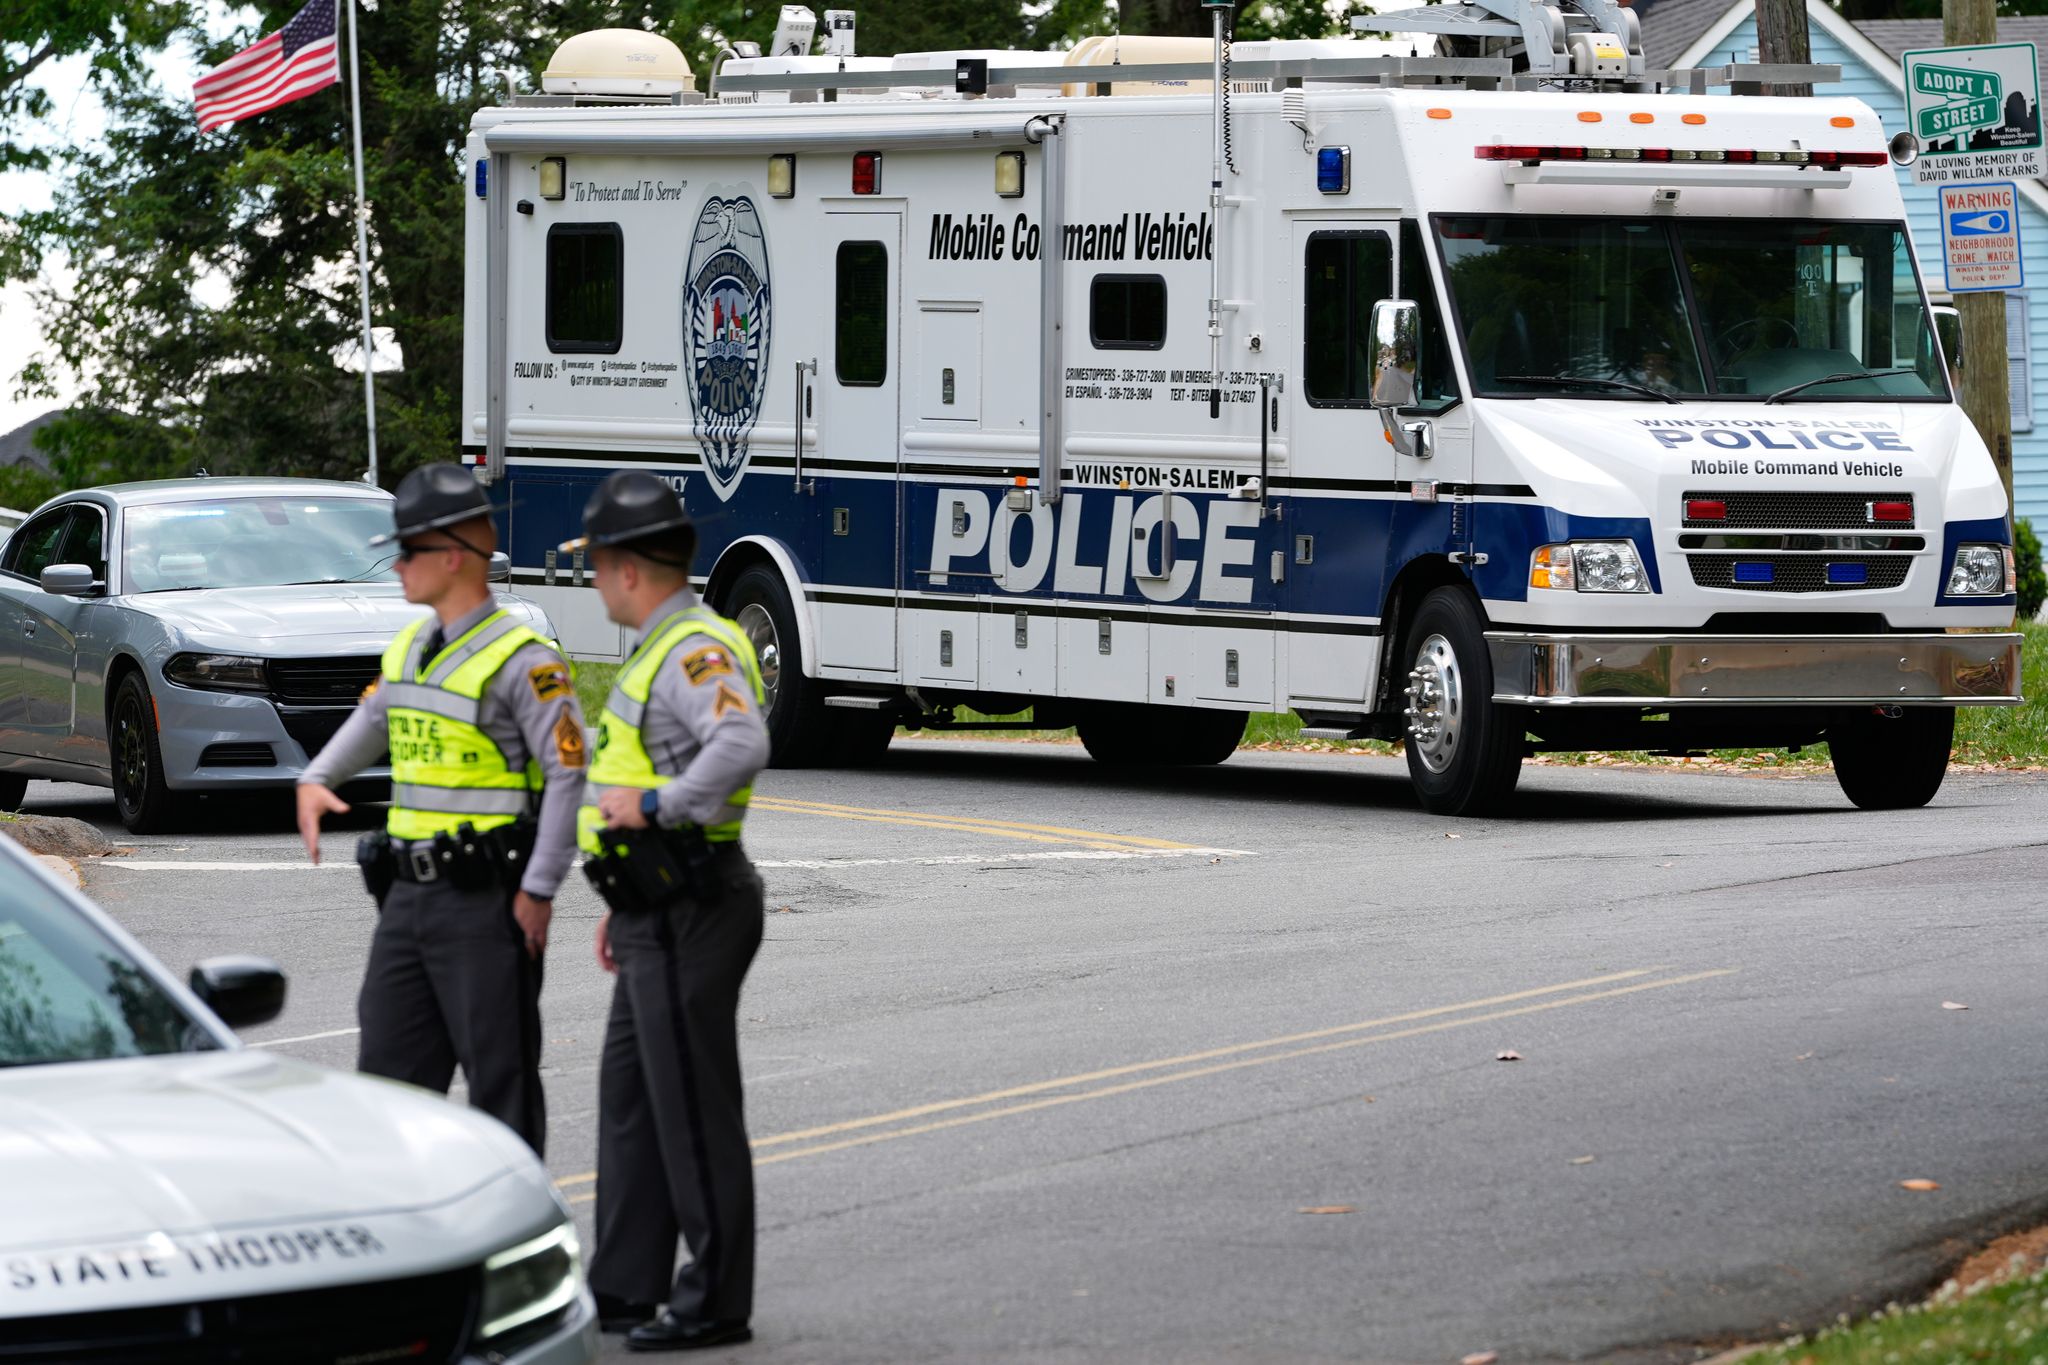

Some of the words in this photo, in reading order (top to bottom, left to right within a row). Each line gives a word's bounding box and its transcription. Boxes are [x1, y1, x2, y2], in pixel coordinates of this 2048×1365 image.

[1923, 72, 1974, 93] ADOPT
[1982, 79, 1993, 95] A
[1932, 104, 1986, 129] STREET
[1990, 131, 2037, 141] Winston-Salem
[2000, 138, 2028, 146] Beautiful
[1921, 159, 1931, 170] IN
[1936, 156, 1971, 169] LOVING
[1975, 153, 2018, 168] MEMORY
[2023, 152, 2036, 163] OF
[1920, 170, 1948, 181] DAVID
[1952, 167, 1993, 180] WILLIAM
[1999, 164, 2039, 177] KEARNS
[587, 181, 620, 202] Protect
[621, 180, 641, 201] and
[643, 181, 654, 201] To
[1946, 191, 2011, 209] WARNING
[928, 212, 1006, 261] Mobile
[1011, 211, 1129, 262] Comand
[1949, 237, 2014, 250] NEIGHBORHOOD
[1951, 252, 1977, 264] CRIME
[1987, 251, 2014, 262] WATCH
[513, 362, 542, 378] FOLLOW
[543, 363, 554, 378] US
[1065, 367, 1116, 381] CRIMESTOPPERS
[1121, 369, 1167, 383] 336-727-2800
[1170, 370, 1185, 383] NON
[1185, 370, 1224, 384] EMERGEY
[700, 362, 754, 414] POLICE
[1065, 385, 1075, 399] EN
[1075, 383, 1102, 399] ESPAÑOL
[1170, 388, 1186, 401] TEXT
[1191, 388, 1223, 402] BITEBK
[1223, 389, 1231, 402] to
[1231, 390, 1256, 403] 274637
[1633, 419, 1894, 430] WINSTON-SALEM
[1647, 429, 1915, 453] POLICE
[1075, 463, 1235, 490] WINSTON-SALEM
[1691, 459, 1749, 475] Mobile
[1754, 459, 1839, 476] Command
[1842, 461, 1904, 477] Vehicle
[927, 487, 1262, 604] POLICE
[6, 1254, 169, 1290] STATE
[184, 1224, 387, 1274] TROOPER
